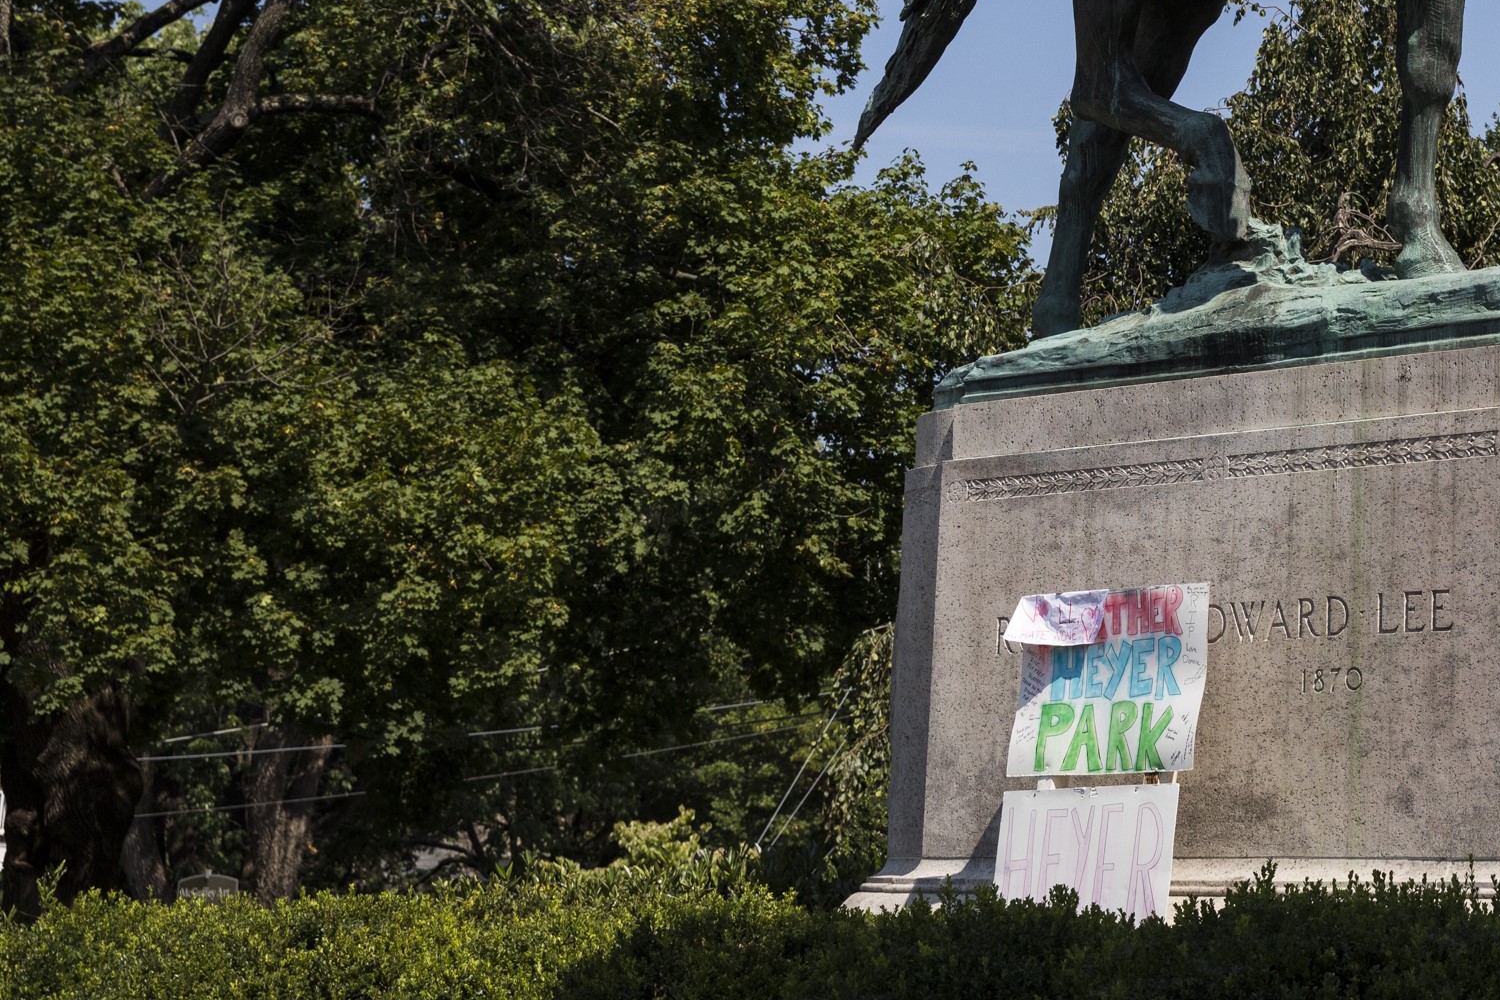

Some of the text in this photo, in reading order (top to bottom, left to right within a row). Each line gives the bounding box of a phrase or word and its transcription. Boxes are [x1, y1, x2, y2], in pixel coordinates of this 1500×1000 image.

[1377, 589, 1454, 635] LEE
[1050, 635, 1182, 702] HEYER
[1301, 666, 1363, 694] 1870
[1033, 700, 1175, 773] PARK
